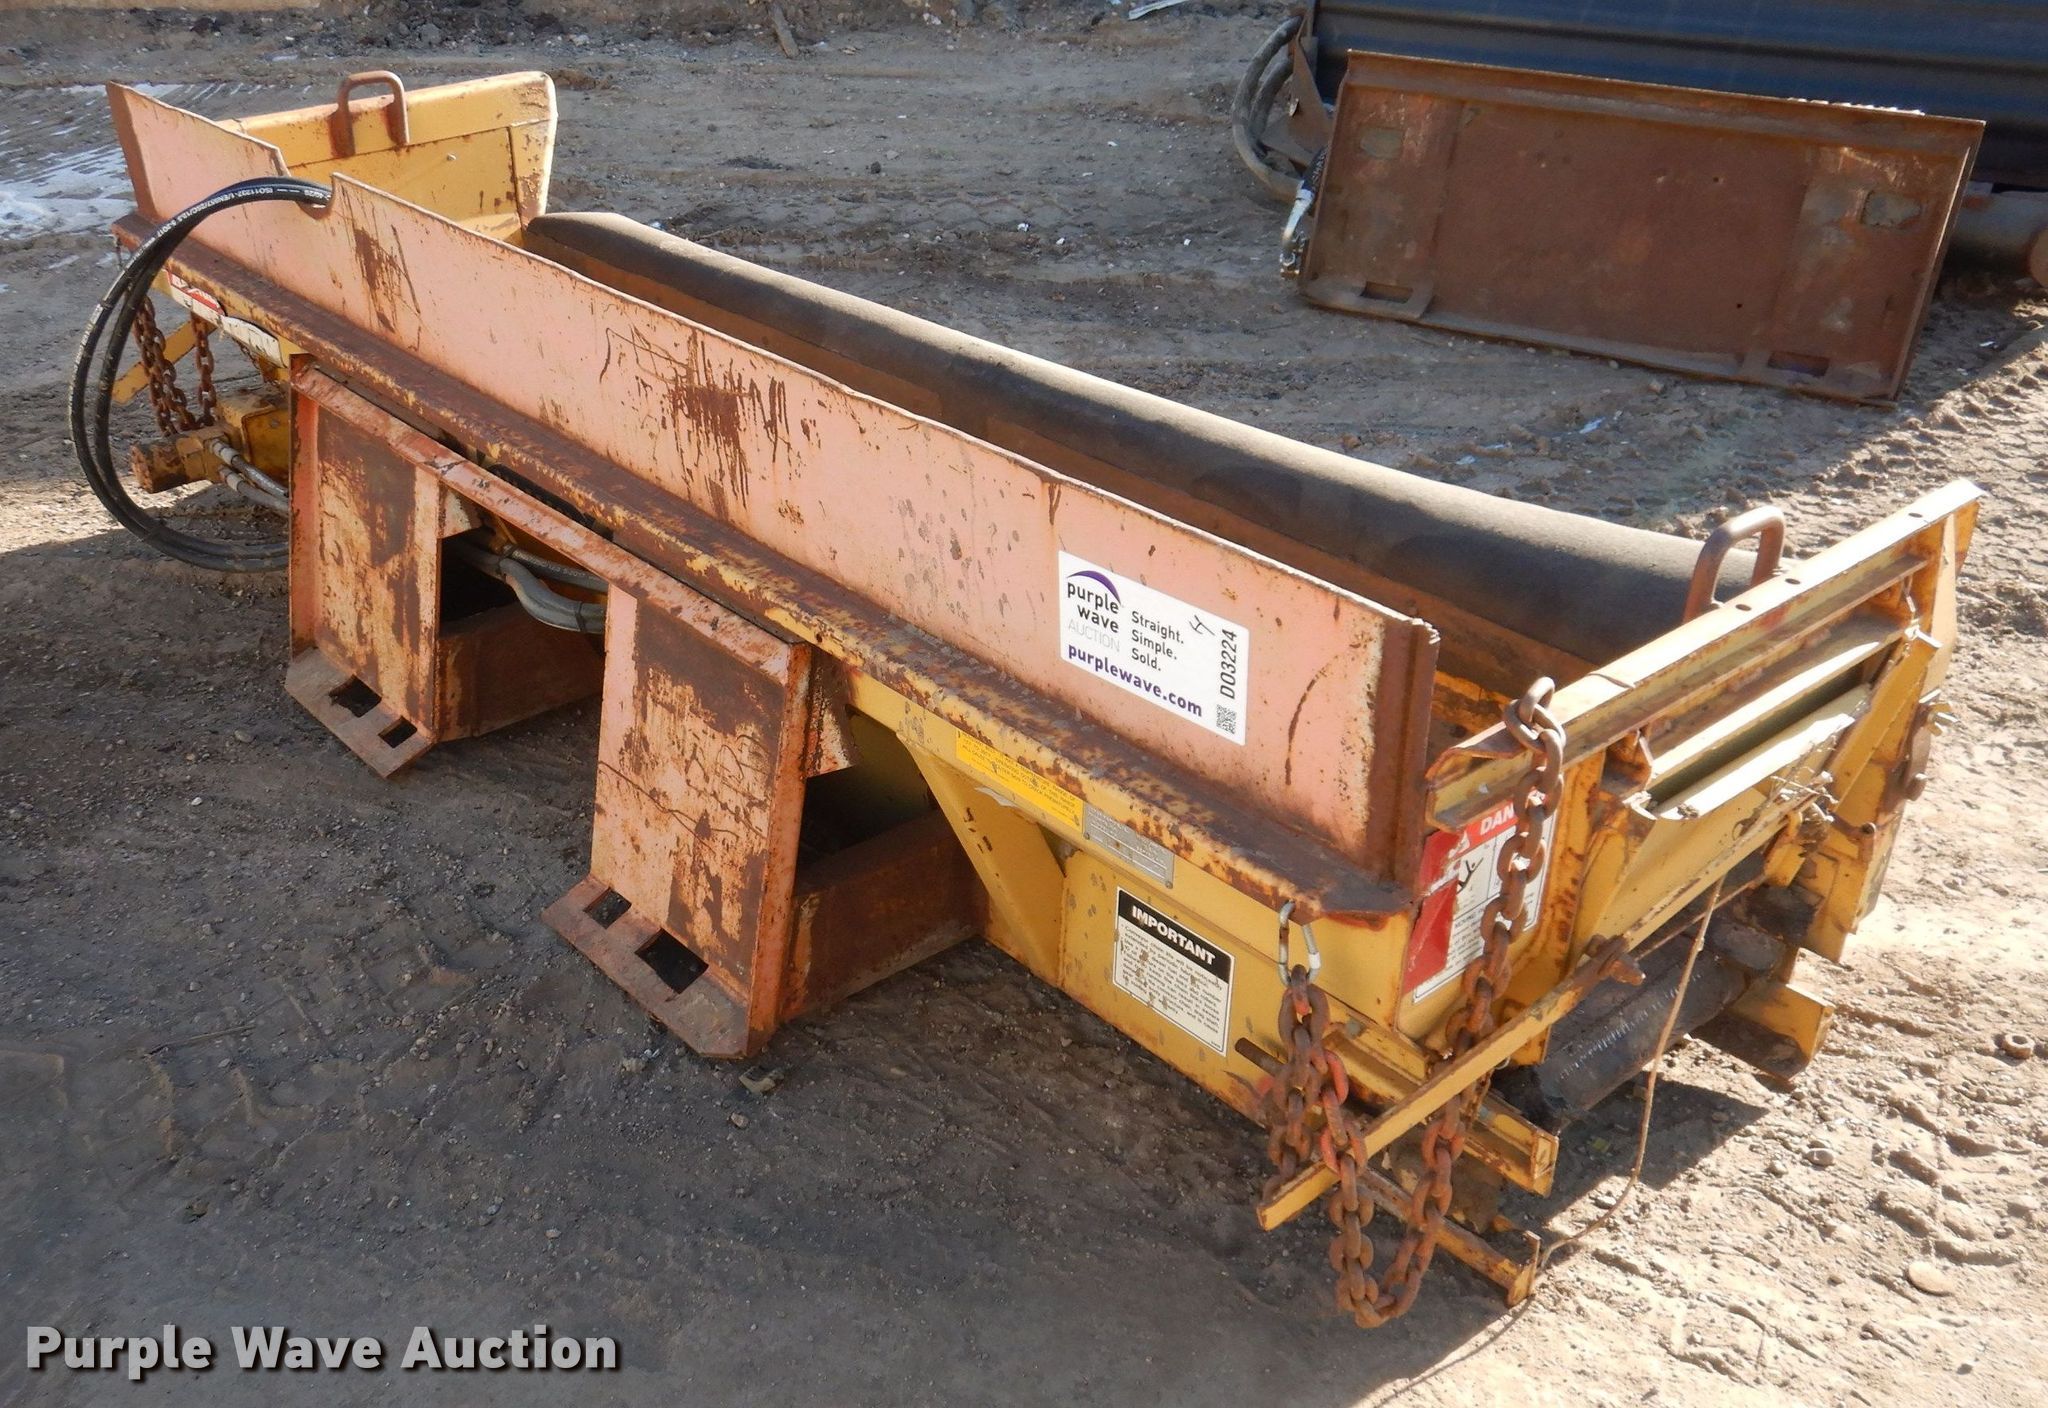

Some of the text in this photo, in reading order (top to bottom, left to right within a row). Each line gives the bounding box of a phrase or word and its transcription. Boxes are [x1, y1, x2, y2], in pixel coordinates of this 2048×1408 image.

[1067, 582, 1119, 614] purple
[1077, 604, 1119, 633] wave
[1131, 611, 1184, 644] Straight.
[1068, 619, 1120, 652] AUCTION
[1131, 629, 1177, 660] Simple.
[1131, 647, 1161, 671] Sold.
[1220, 628, 1238, 700] D03224
[1068, 644, 1202, 717] purplewave.com
[1132, 905, 1216, 966] IMPORTANT
